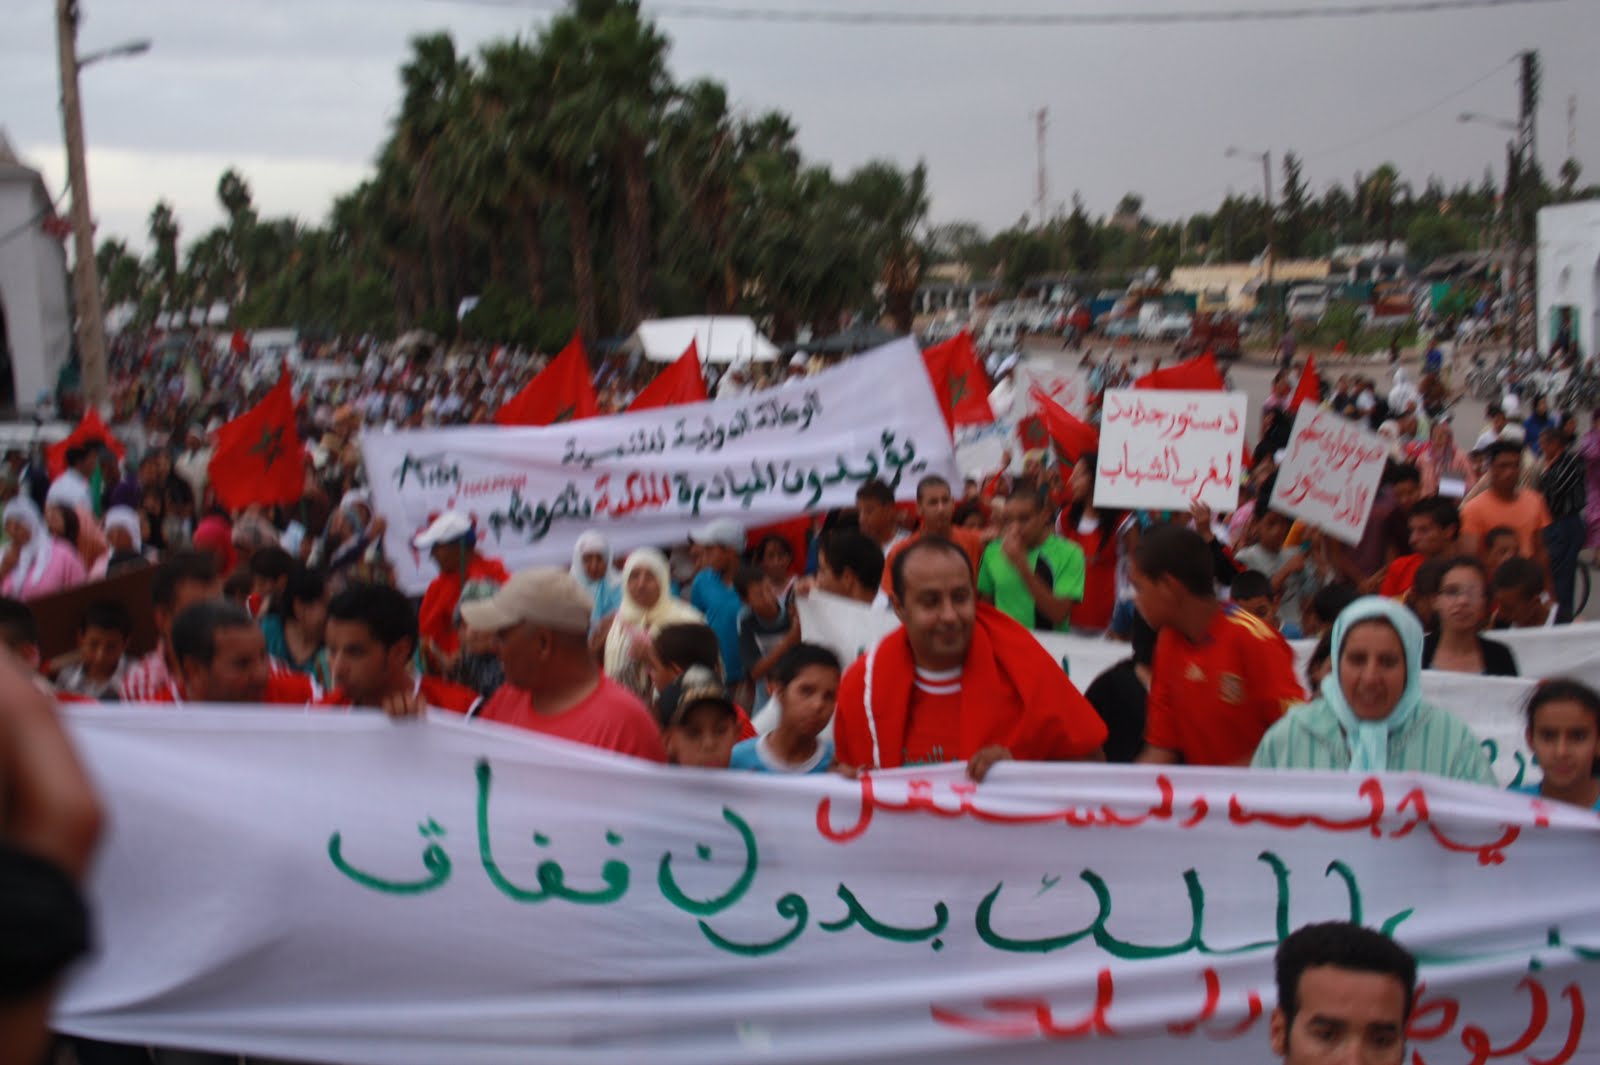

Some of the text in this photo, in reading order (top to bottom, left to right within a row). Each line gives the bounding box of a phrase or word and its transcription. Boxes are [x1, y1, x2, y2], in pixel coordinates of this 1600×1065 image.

[1162, 403, 1239, 440] دستور
[1099, 442, 1181, 485] الشباب
[652, 805, 949, 957] بدون
